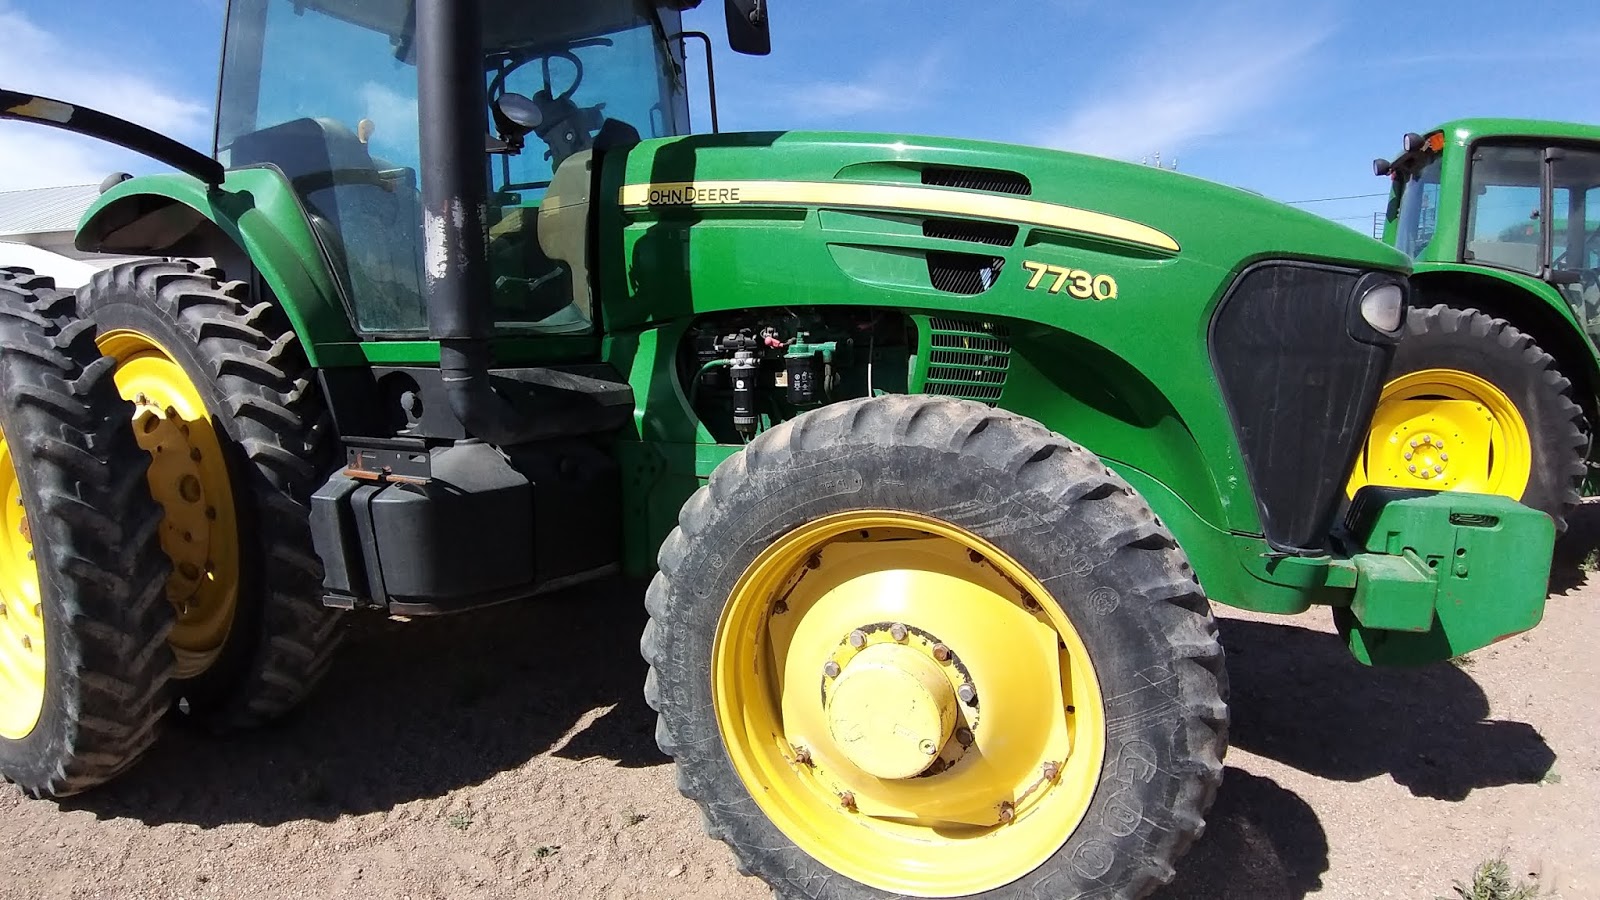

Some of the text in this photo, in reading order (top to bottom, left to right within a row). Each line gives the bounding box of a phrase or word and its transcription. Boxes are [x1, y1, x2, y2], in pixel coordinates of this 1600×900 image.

[641, 186, 740, 204] JOHN DEERE
[1022, 260, 1118, 301] 7730
